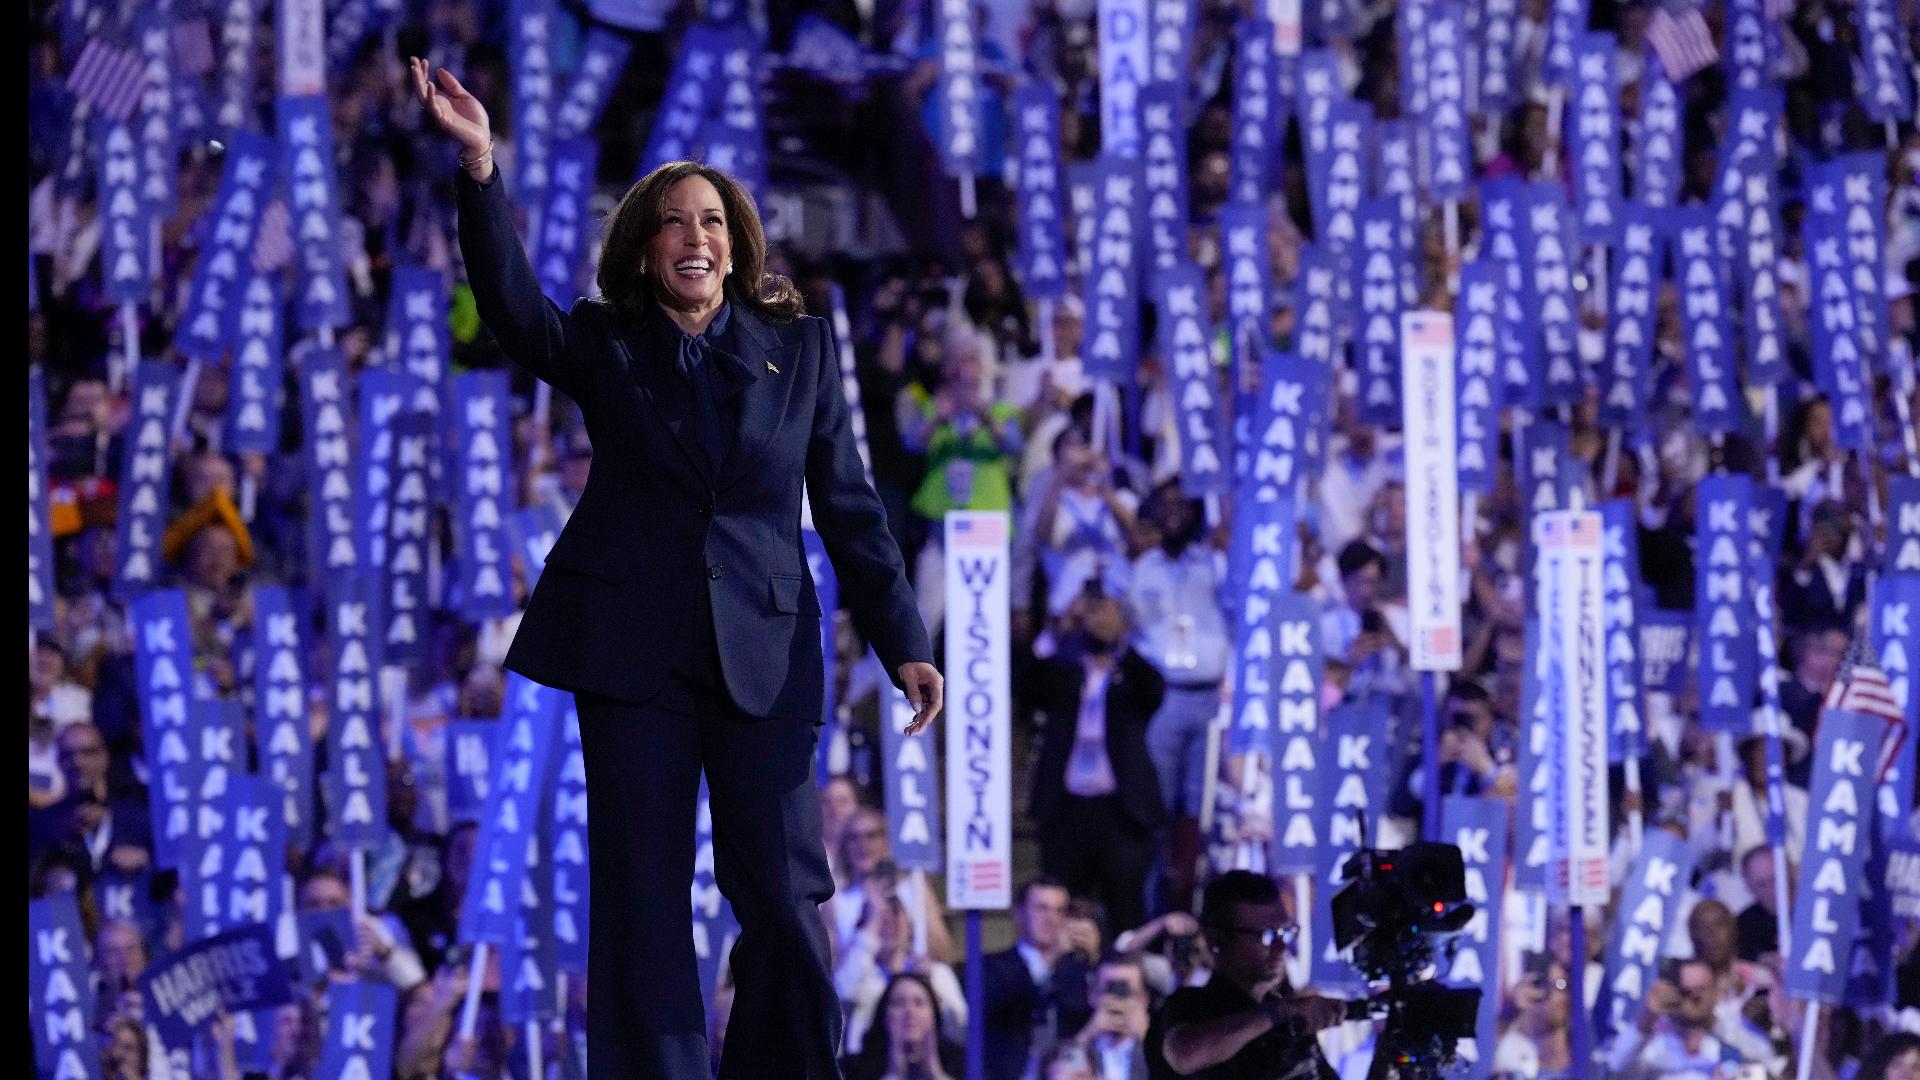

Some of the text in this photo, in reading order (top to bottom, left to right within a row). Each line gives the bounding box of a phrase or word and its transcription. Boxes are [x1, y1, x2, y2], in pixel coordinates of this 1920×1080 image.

[657, 51, 713, 161] KAMA
[1022, 106, 1057, 277] KAMALA
[1428, 20, 1463, 184] KAMALA
[1579, 54, 1612, 226] KAMALA
[1644, 80, 1677, 207] AMALA
[106, 127, 140, 281] AMALA
[191, 156, 264, 341] KAMALA
[289, 115, 335, 303] KAMALA
[545, 160, 583, 284] KAMA
[1092, 177, 1132, 359] KAMALA
[1531, 205, 1573, 382] KAMALA
[1747, 176, 1779, 364] KAMALA
[237, 278, 274, 430] AMALA
[1168, 285, 1219, 472] KAMALA
[1363, 220, 1396, 403] KAMALA
[1460, 282, 1496, 471] KAMALA
[1607, 225, 1652, 409] KAMALA
[1681, 227, 1727, 411] KAMALA
[1815, 238, 1864, 425] KAMALA
[122, 383, 167, 581] KAMALA
[311, 369, 356, 567] KAMALA
[388, 435, 426, 643] KAMALA
[466, 396, 501, 598] KAMALA
[1603, 525, 1641, 733] KAMALA
[1707, 500, 1742, 707] KAMALA
[146, 617, 188, 841] KAMALA
[337, 602, 373, 824] KAMALA
[957, 558, 997, 848] WISCONSIN
[1279, 620, 1317, 847] KAMALA
[1802, 738, 1864, 974] KAMALA
[38, 928, 88, 1080] KAMA
